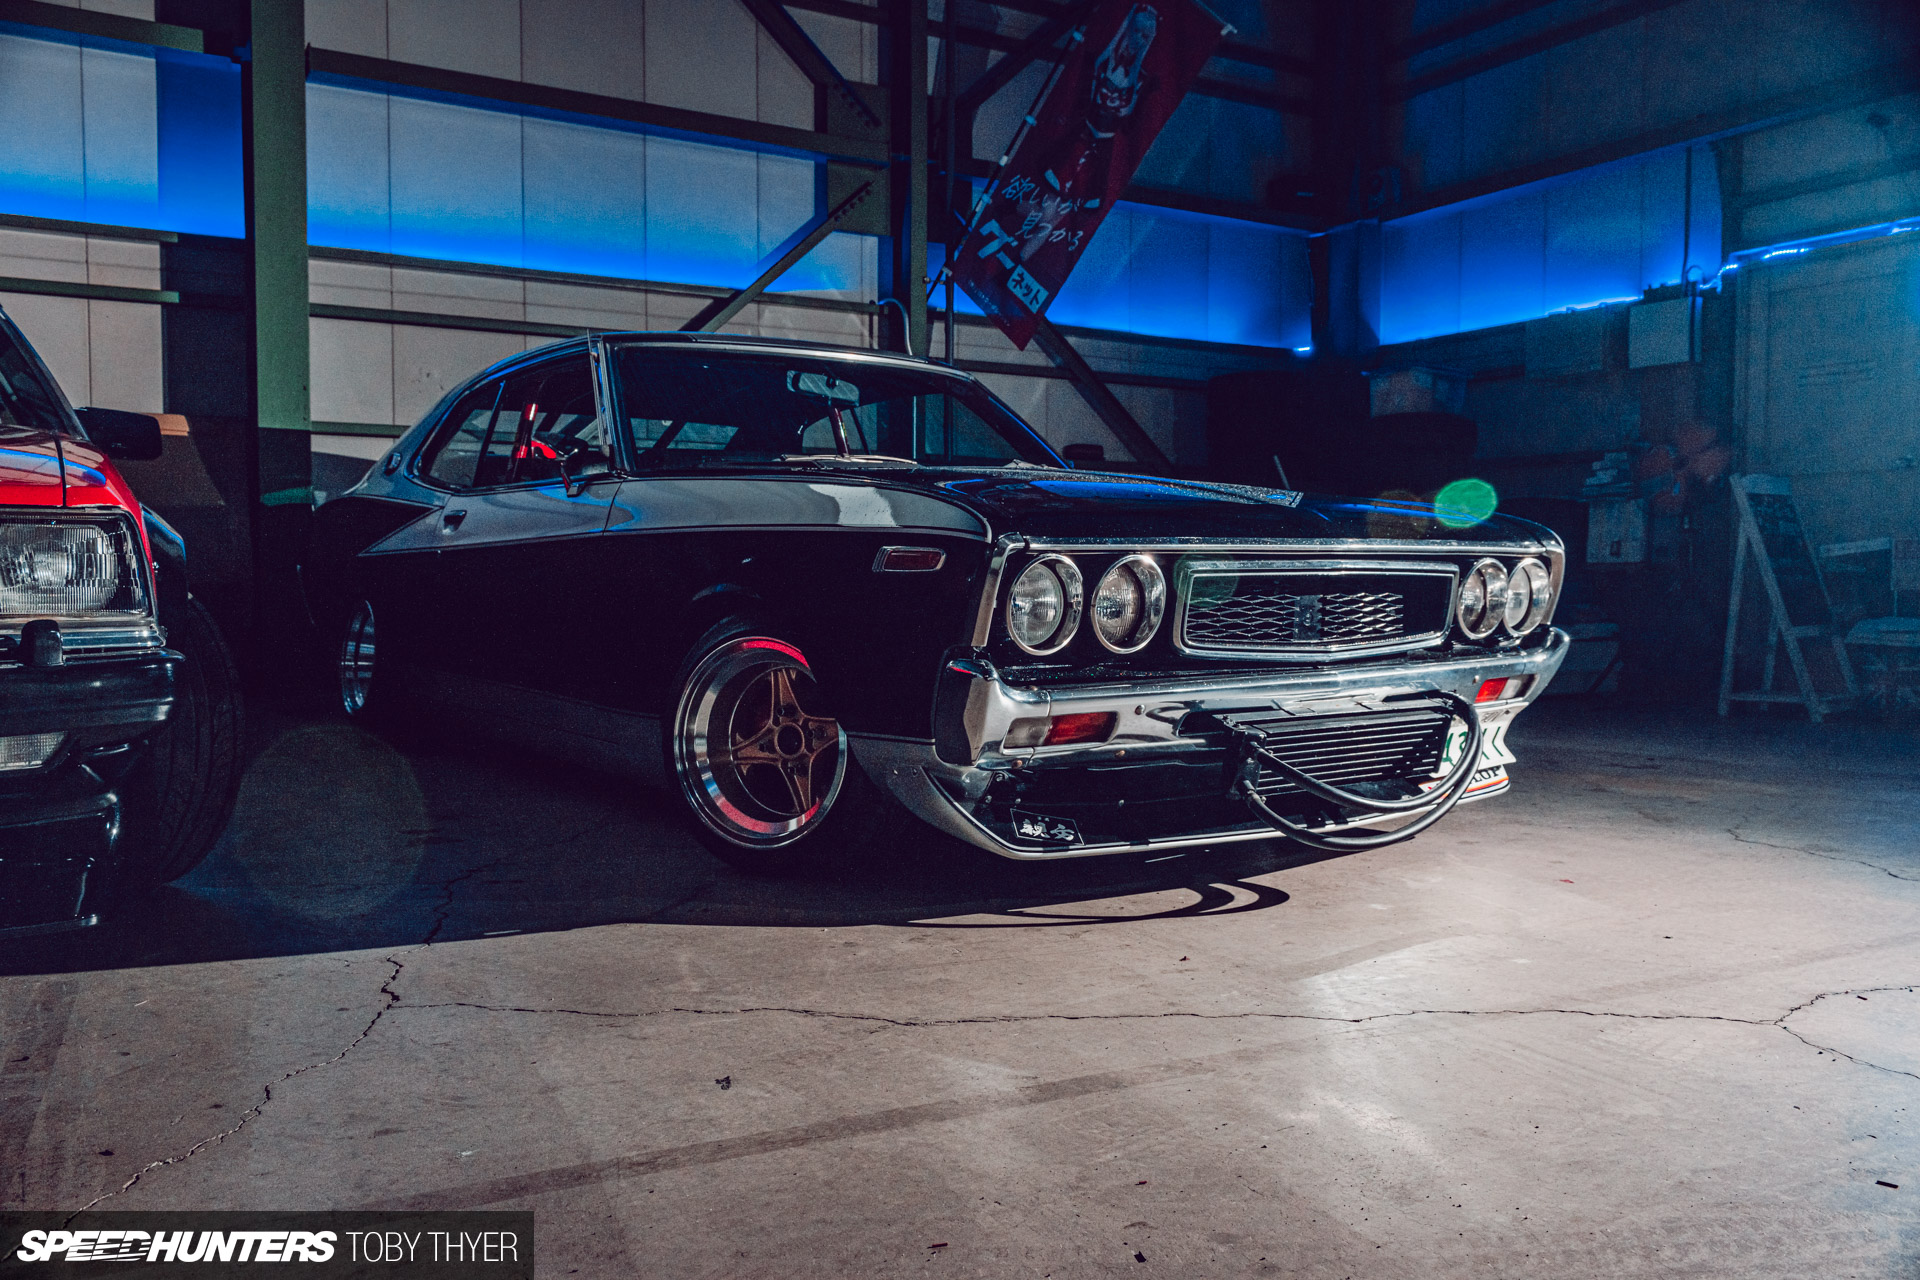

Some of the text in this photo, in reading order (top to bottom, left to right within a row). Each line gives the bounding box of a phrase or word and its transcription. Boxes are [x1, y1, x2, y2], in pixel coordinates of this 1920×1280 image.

[1003, 175, 1083, 215] 欲しいが
[1015, 211, 1083, 251] 見つかる
